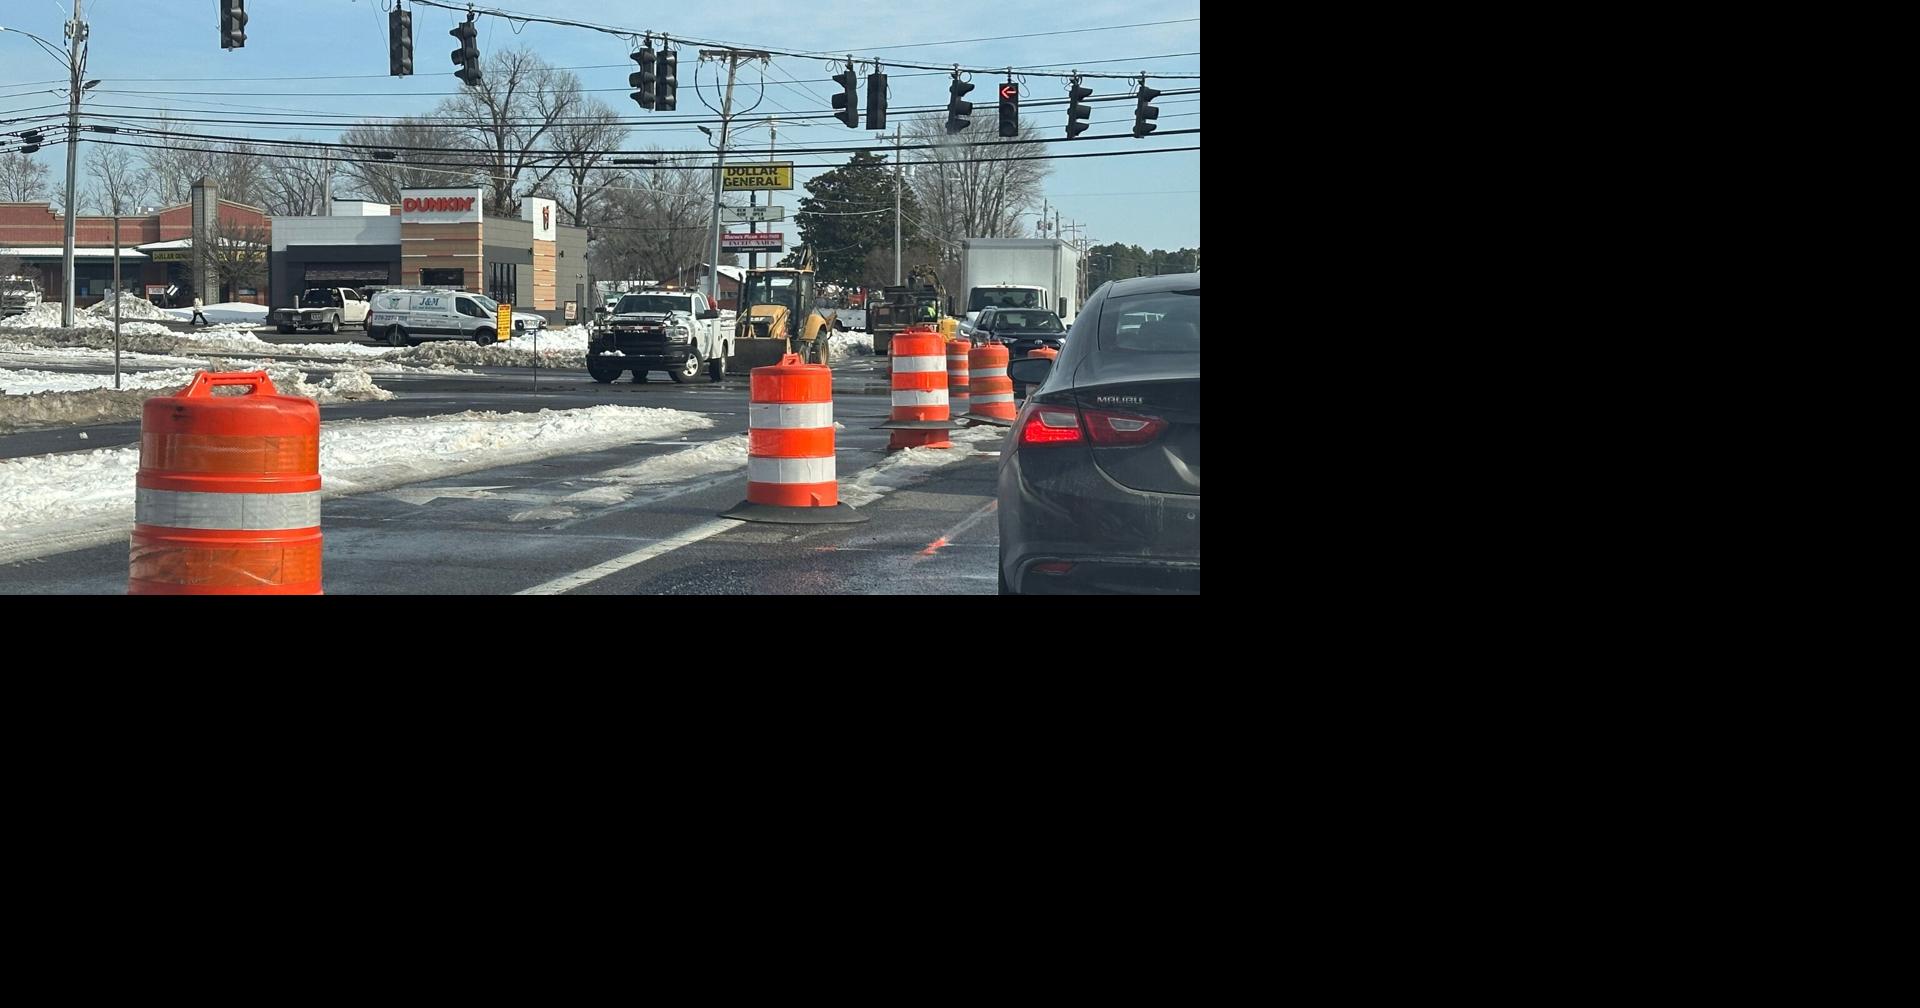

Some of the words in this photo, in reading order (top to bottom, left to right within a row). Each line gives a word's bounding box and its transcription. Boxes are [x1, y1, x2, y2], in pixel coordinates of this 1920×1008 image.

[727, 166, 778, 176] DOLLAR
[723, 177, 782, 187] GENERAL
[403, 197, 476, 213] DUNKIN'
[419, 297, 440, 306] J&M
[1097, 396, 1143, 404] MALIBU
